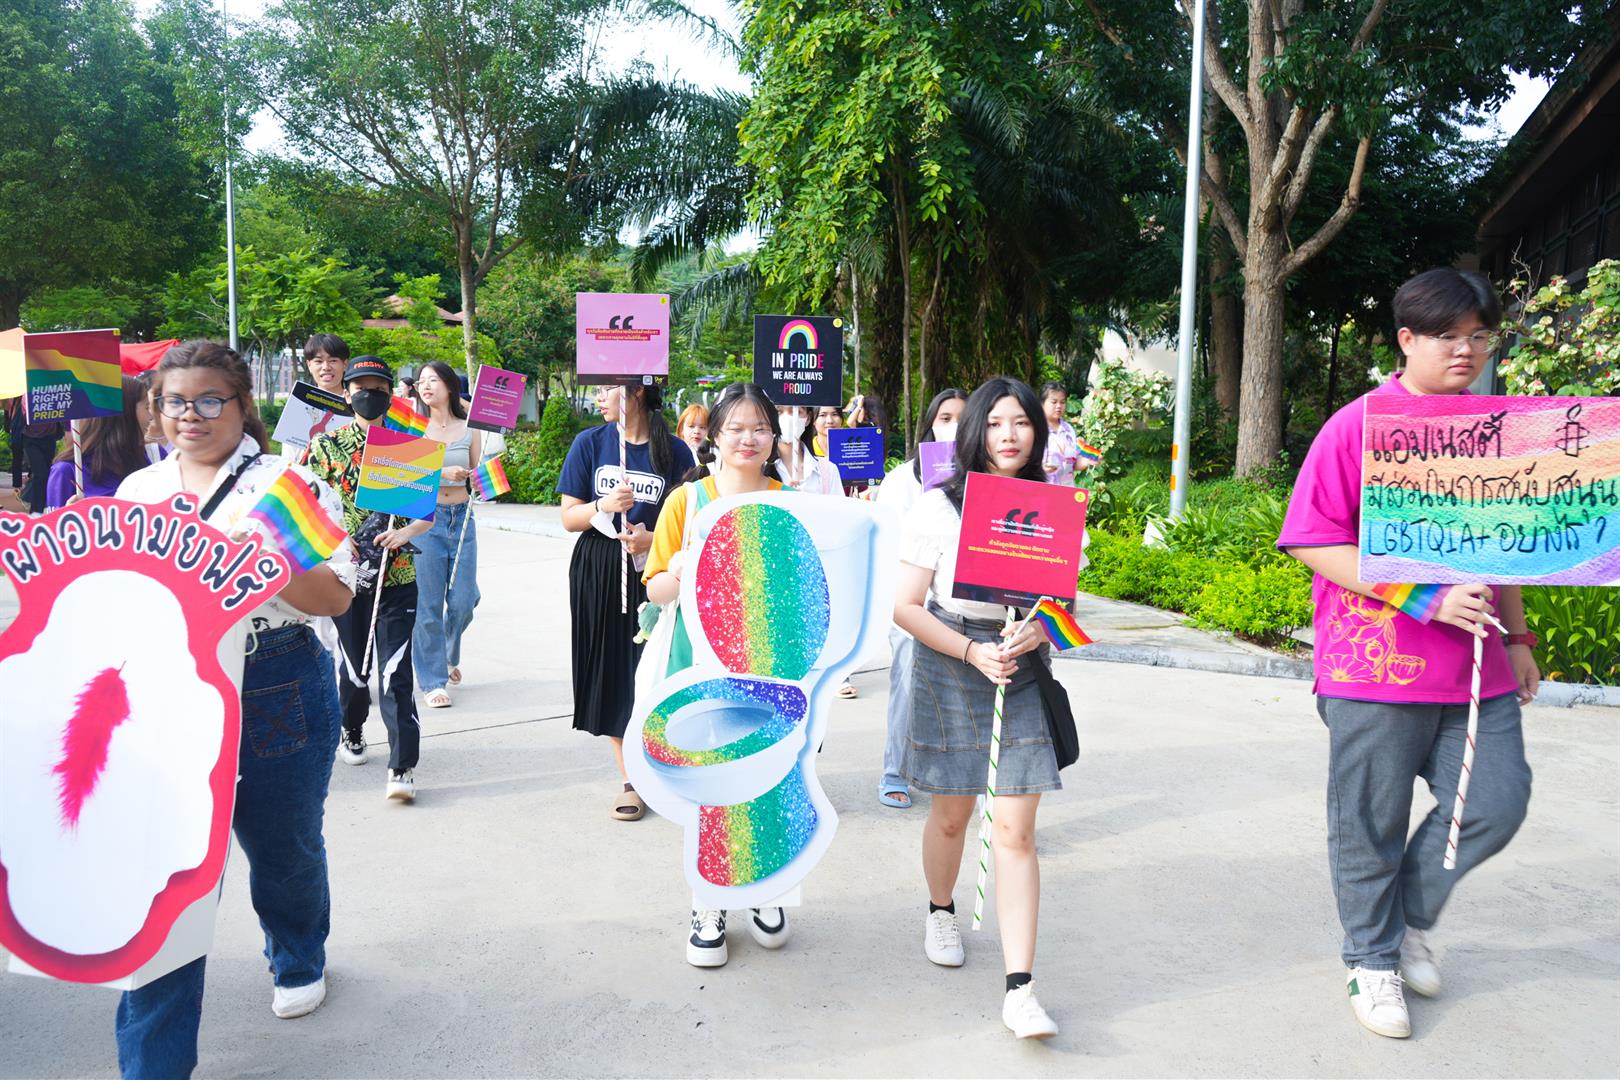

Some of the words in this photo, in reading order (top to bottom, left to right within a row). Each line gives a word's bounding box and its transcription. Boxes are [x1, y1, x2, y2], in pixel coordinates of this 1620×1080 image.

[772, 353, 783, 368] IN
[790, 353, 824, 369] PRIDE
[772, 370, 782, 379] WE
[784, 371, 796, 380] ARE
[797, 371, 822, 380] ALWAYS
[32, 383, 72, 395] HUMAN
[783, 383, 811, 393] PROUD
[32, 392, 72, 404] RIGHTS
[32, 402, 55, 412] ARE
[57, 400, 72, 409] MY
[33, 410, 64, 419] PRIDE
[1372, 410, 1508, 464] แอมเนสตี้
[1368, 517, 1490, 557] LGBTQIA+
[1, 496, 281, 608] ผ้าอนามัยฟรี
